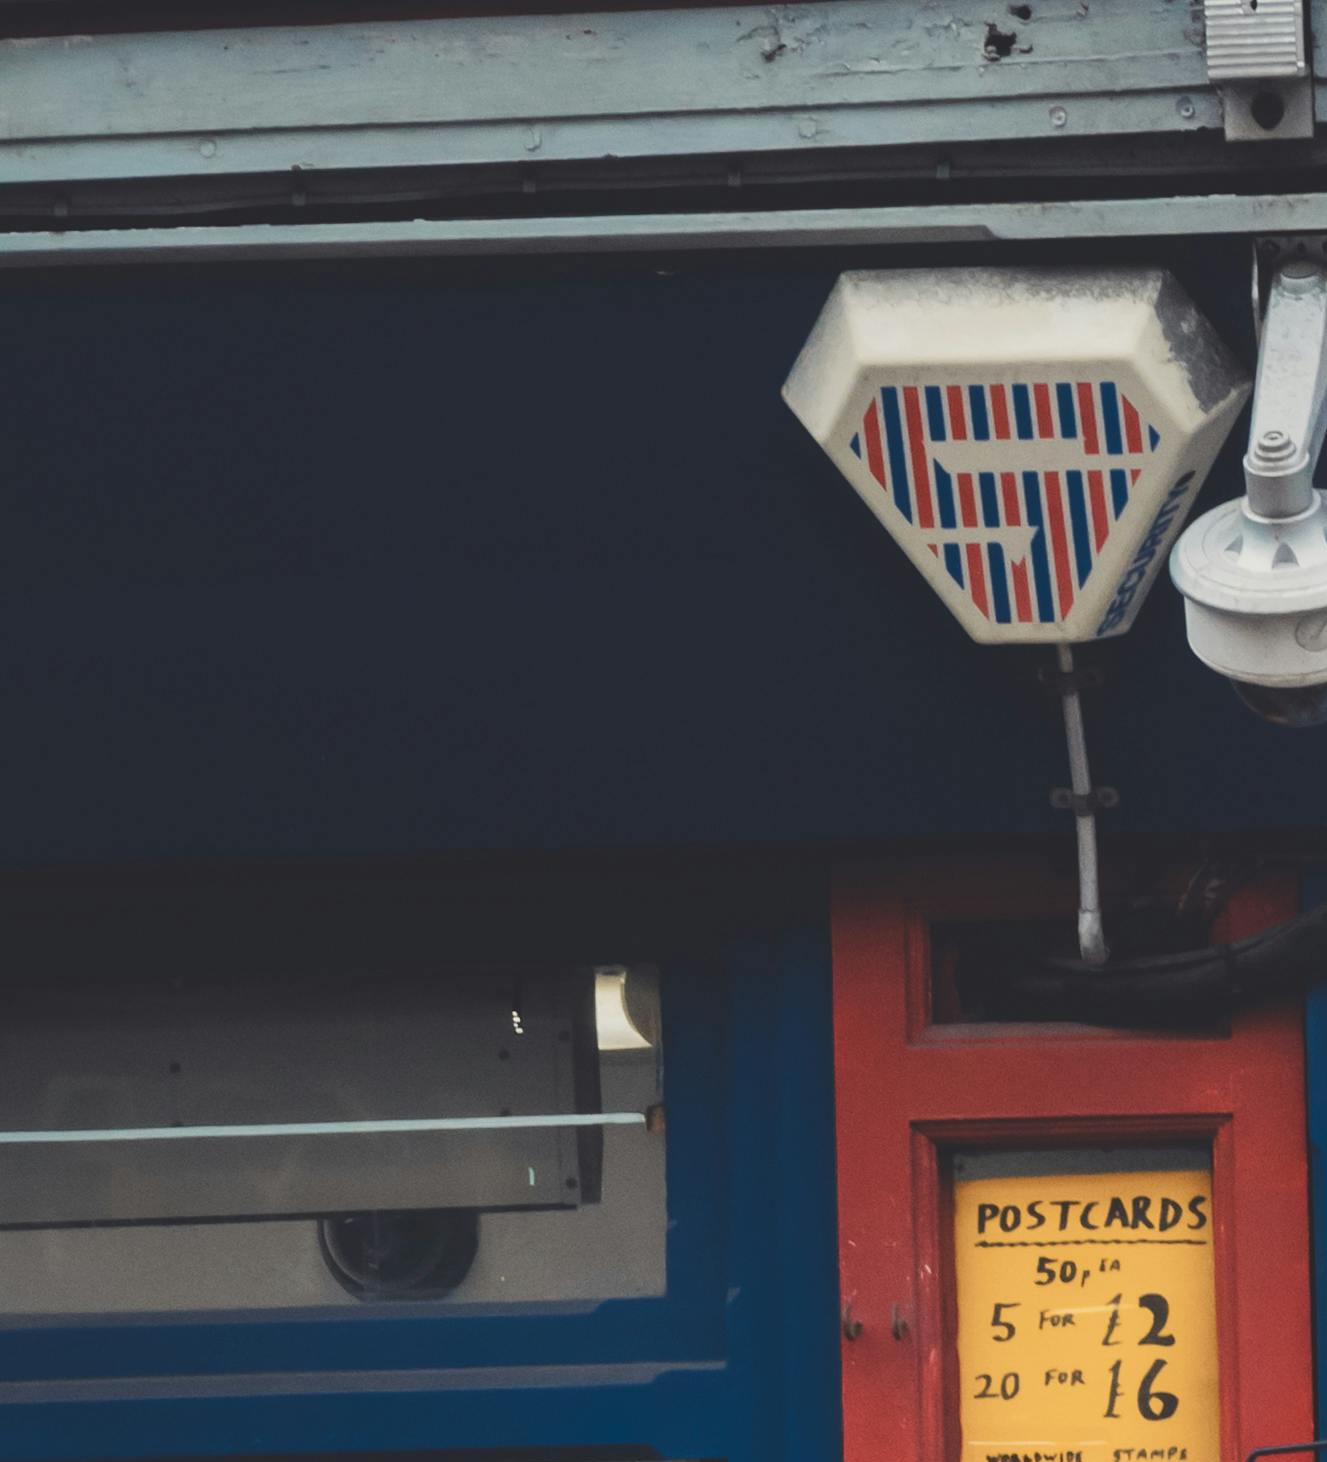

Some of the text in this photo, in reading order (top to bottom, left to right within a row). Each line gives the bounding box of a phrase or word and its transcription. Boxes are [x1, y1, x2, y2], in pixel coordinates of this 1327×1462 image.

[977, 1195, 1208, 1234] POSTCARDS
[1034, 1256, 1091, 1288] 50p
[990, 1302, 1021, 1343] 5
[1039, 1310, 1076, 1331] FOR
[973, 1372, 1021, 1401] 20
[1044, 1368, 1086, 1387] FOR
